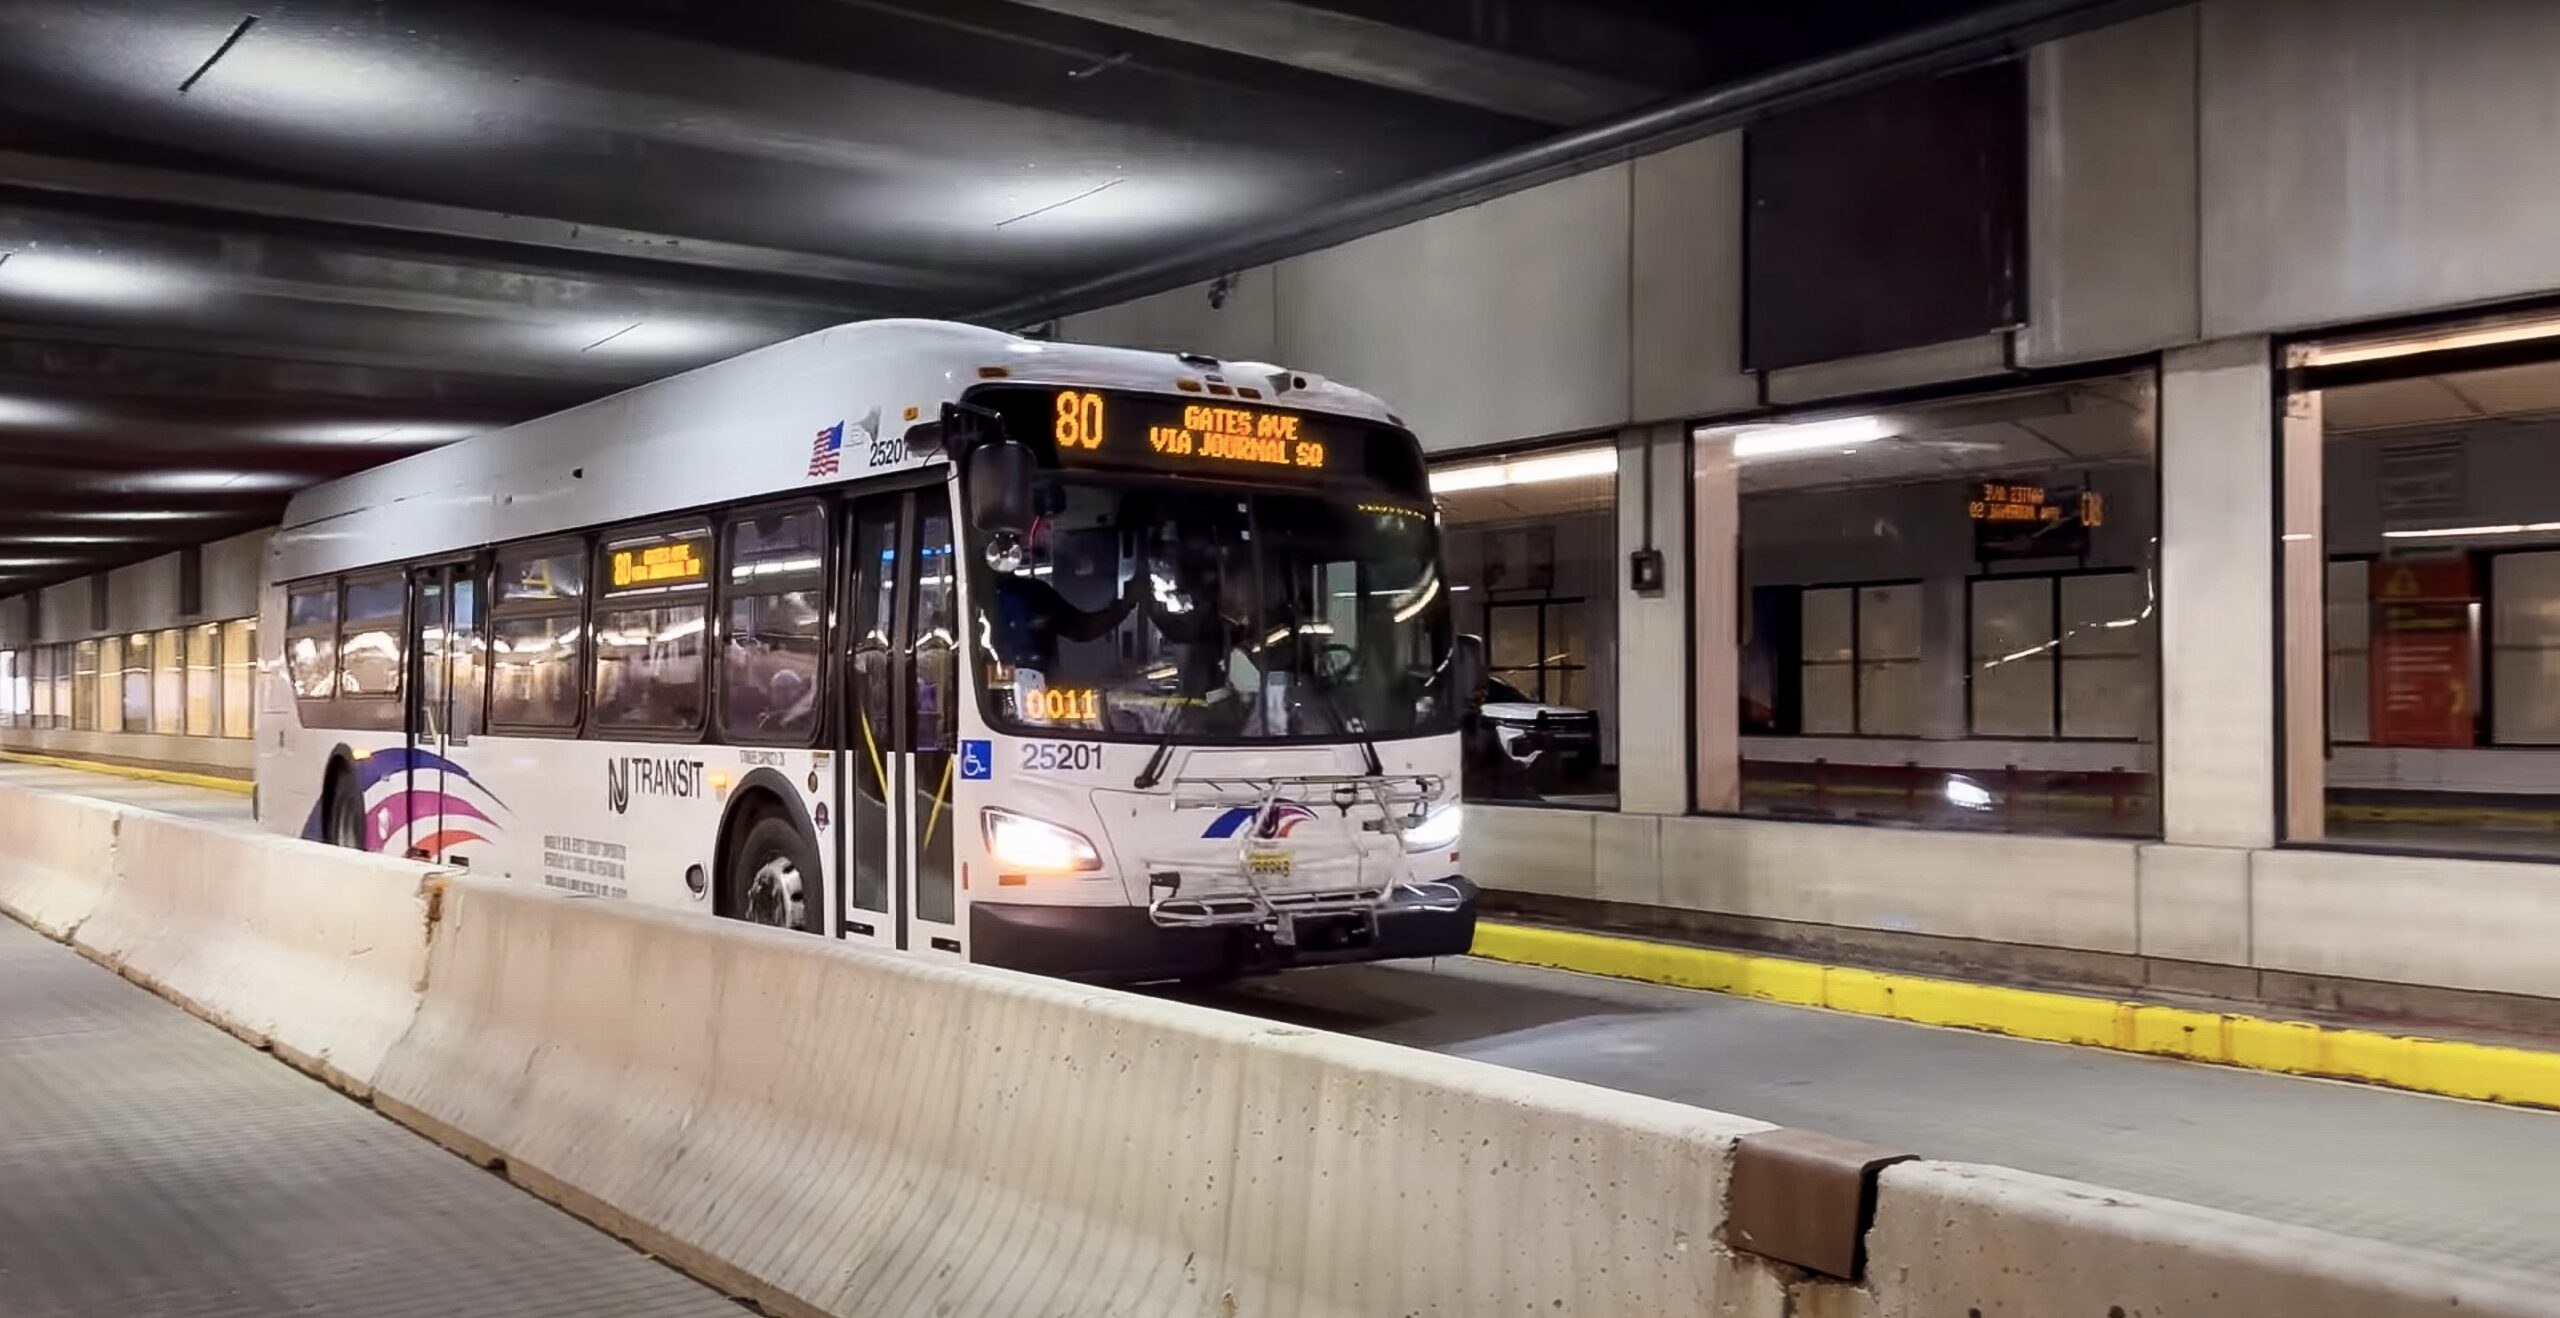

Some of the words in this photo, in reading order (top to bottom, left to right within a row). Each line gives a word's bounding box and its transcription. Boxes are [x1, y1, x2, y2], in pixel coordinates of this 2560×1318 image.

[1055, 391, 1104, 449] 80
[1184, 405, 1251, 436] GATES
[1257, 414, 1299, 441] AVE
[1150, 427, 1192, 455] VIA
[1198, 433, 1290, 464] JOURNAL
[1296, 442, 1324, 467] SQ
[614, 552, 632, 586] 80
[1026, 689, 1097, 718] 0011
[1022, 743, 1102, 770] 25201
[608, 757, 629, 814] NJ
[632, 758, 704, 799] TRANSIT
